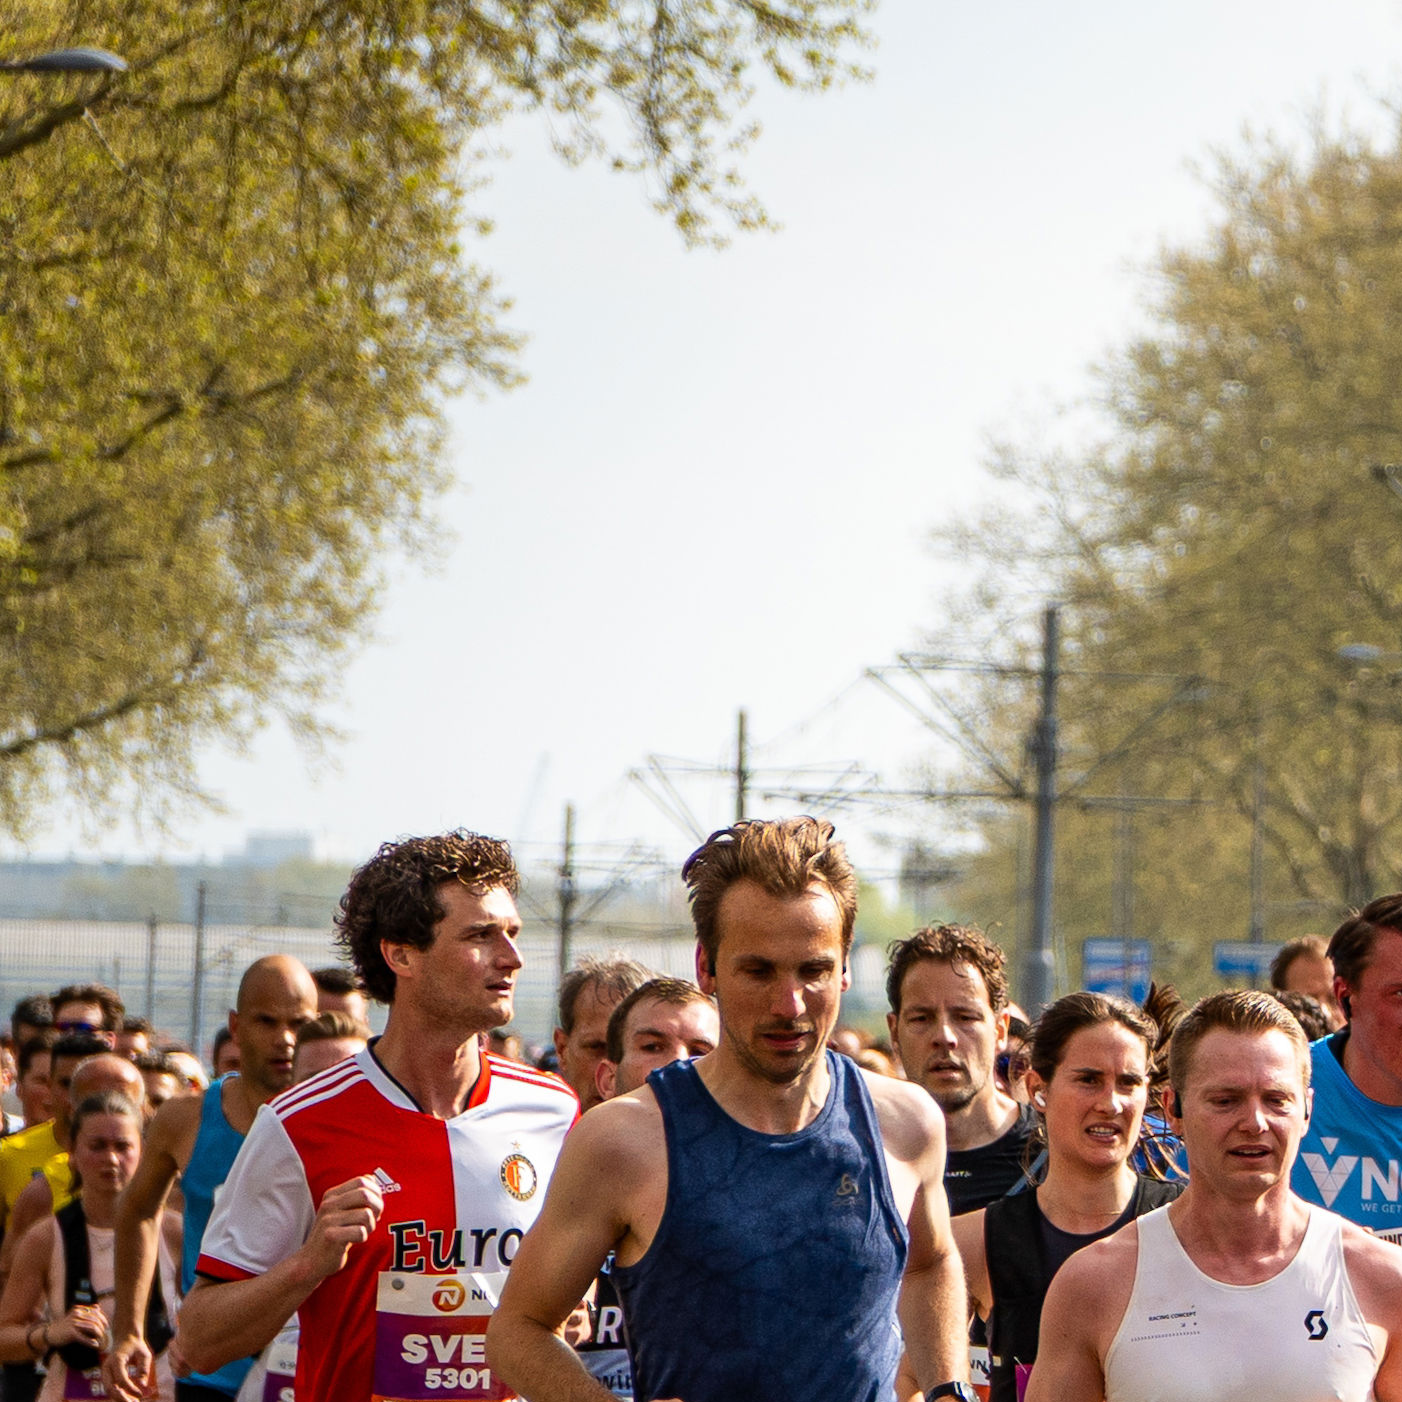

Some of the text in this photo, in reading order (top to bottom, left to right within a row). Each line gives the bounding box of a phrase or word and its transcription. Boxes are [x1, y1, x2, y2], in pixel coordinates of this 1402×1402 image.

[1361, 1203, 1379, 1213] WE
[1381, 1204, 1401, 1214] GET
[424, 1368, 491, 1390] 5301
